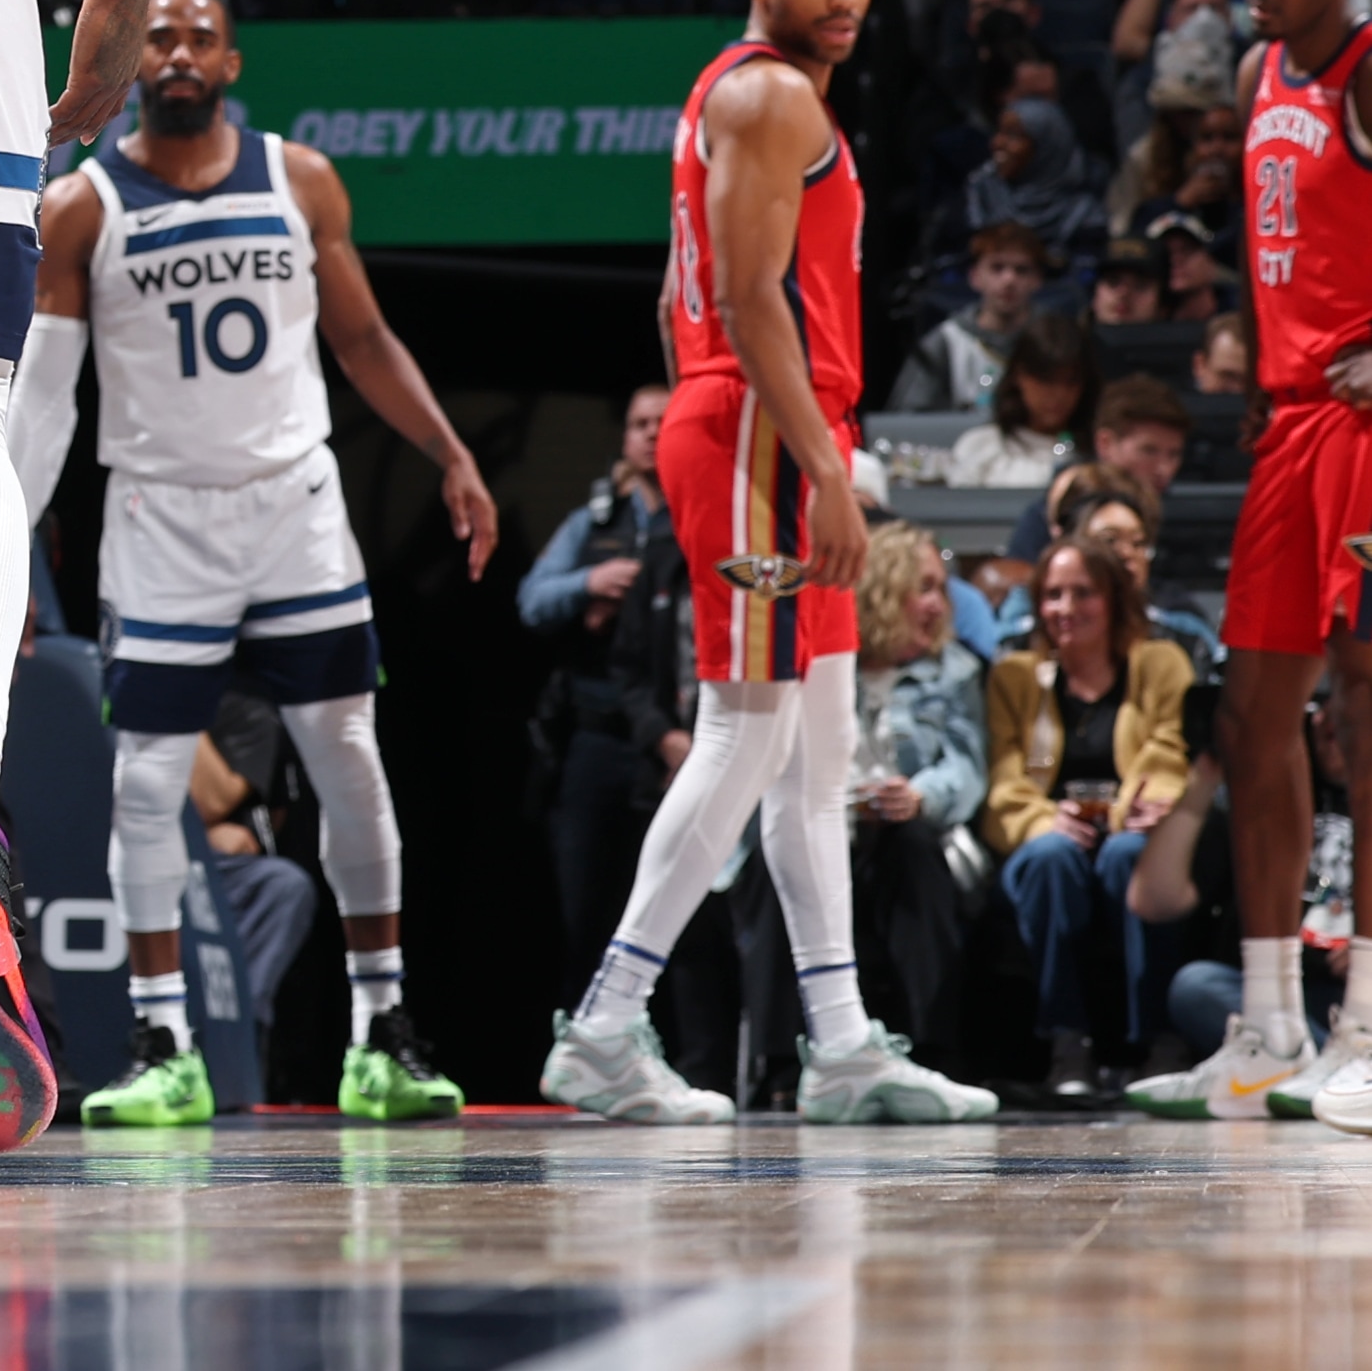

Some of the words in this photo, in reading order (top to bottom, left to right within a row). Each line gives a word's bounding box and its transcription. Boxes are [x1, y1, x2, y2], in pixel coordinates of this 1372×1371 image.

[290, 108, 434, 158] OBEY
[429, 108, 570, 156] YOUR
[1255, 154, 1298, 237] 21
[128, 249, 293, 295] WOLVES
[167, 298, 268, 378] 10
